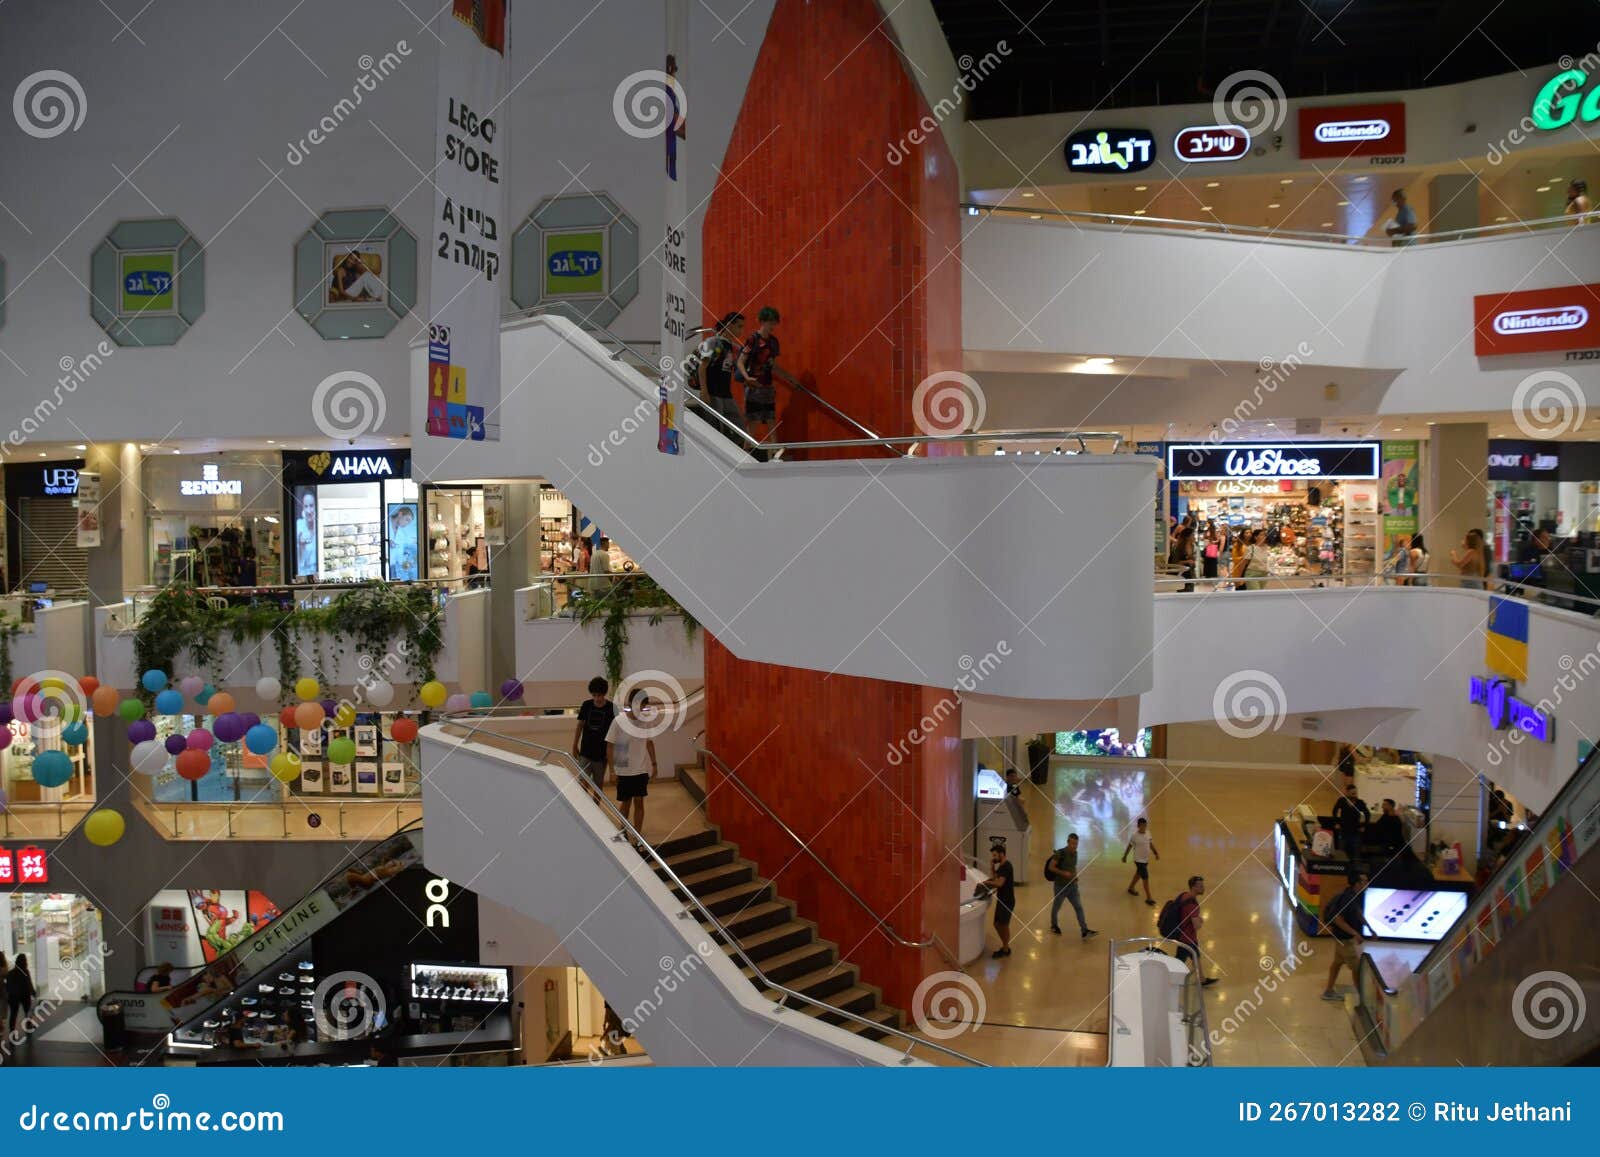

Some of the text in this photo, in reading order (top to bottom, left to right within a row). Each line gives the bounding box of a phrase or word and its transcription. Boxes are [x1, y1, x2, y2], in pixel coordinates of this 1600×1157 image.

[448, 97, 494, 144] LEGO
[1072, 142, 1101, 166] גב
[1189, 133, 1235, 153] שילב
[445, 134, 499, 184] STORE
[442, 197, 498, 240] בניין A
[438, 232, 499, 281] קומה 2
[1501, 311, 1579, 330] Nintendo
[331, 456, 393, 475] AHAVA
[1225, 449, 1321, 475] WeShoes
[1216, 478, 1279, 494] WeShoes
[253, 901, 321, 952] OFFLINE
